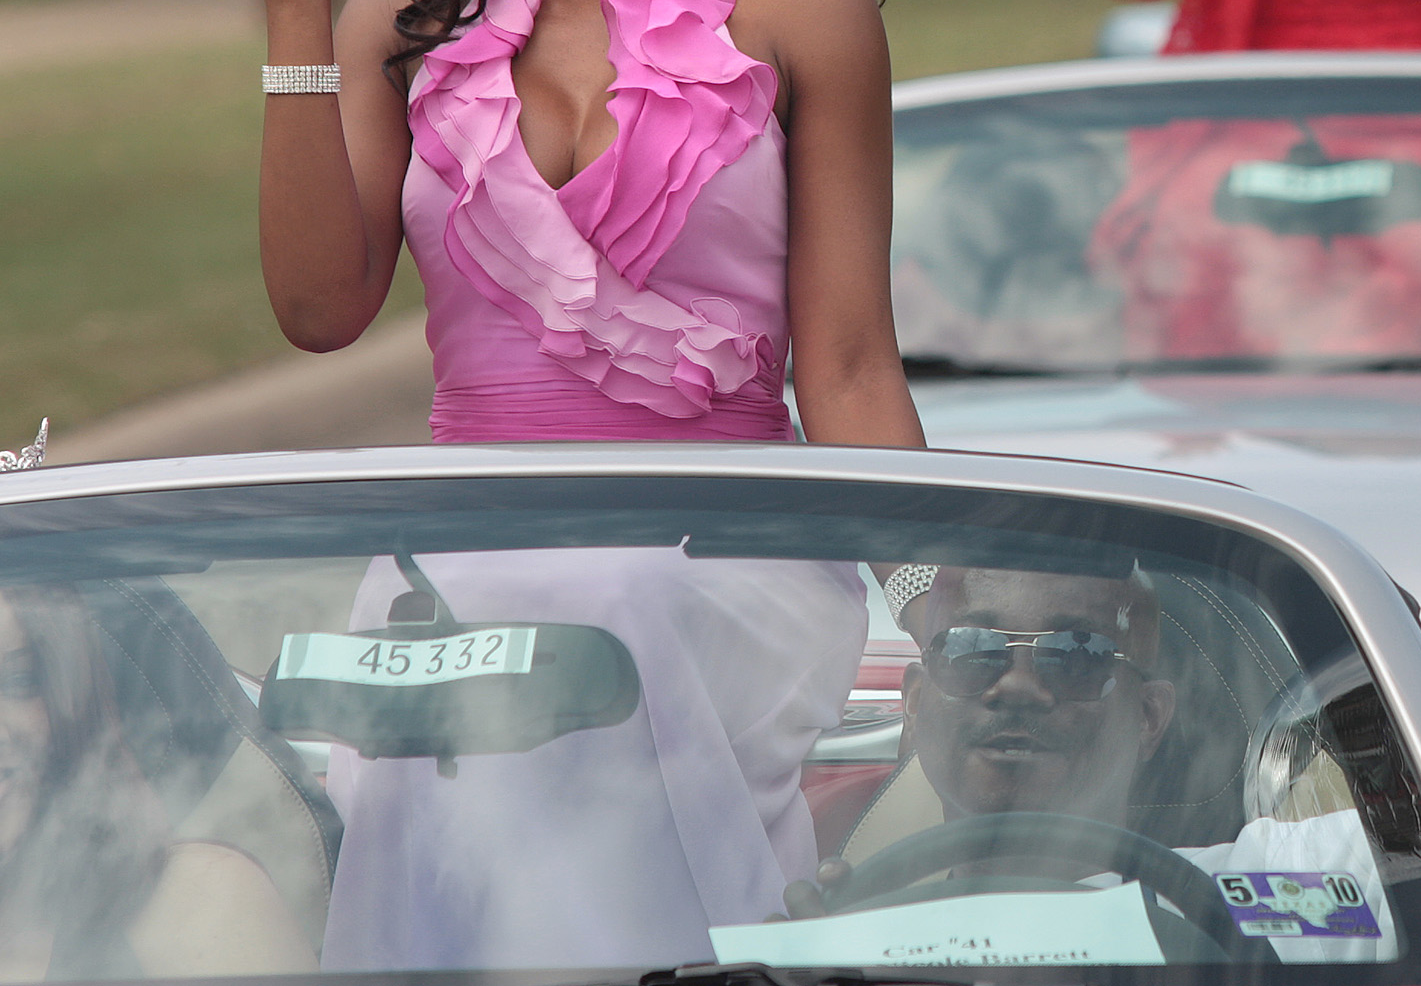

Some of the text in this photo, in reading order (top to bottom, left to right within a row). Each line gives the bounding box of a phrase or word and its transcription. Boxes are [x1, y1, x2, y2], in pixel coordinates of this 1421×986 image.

[1221, 878, 1253, 903] 5
[1326, 877, 1359, 904] 10
[883, 944, 939, 958] Car
